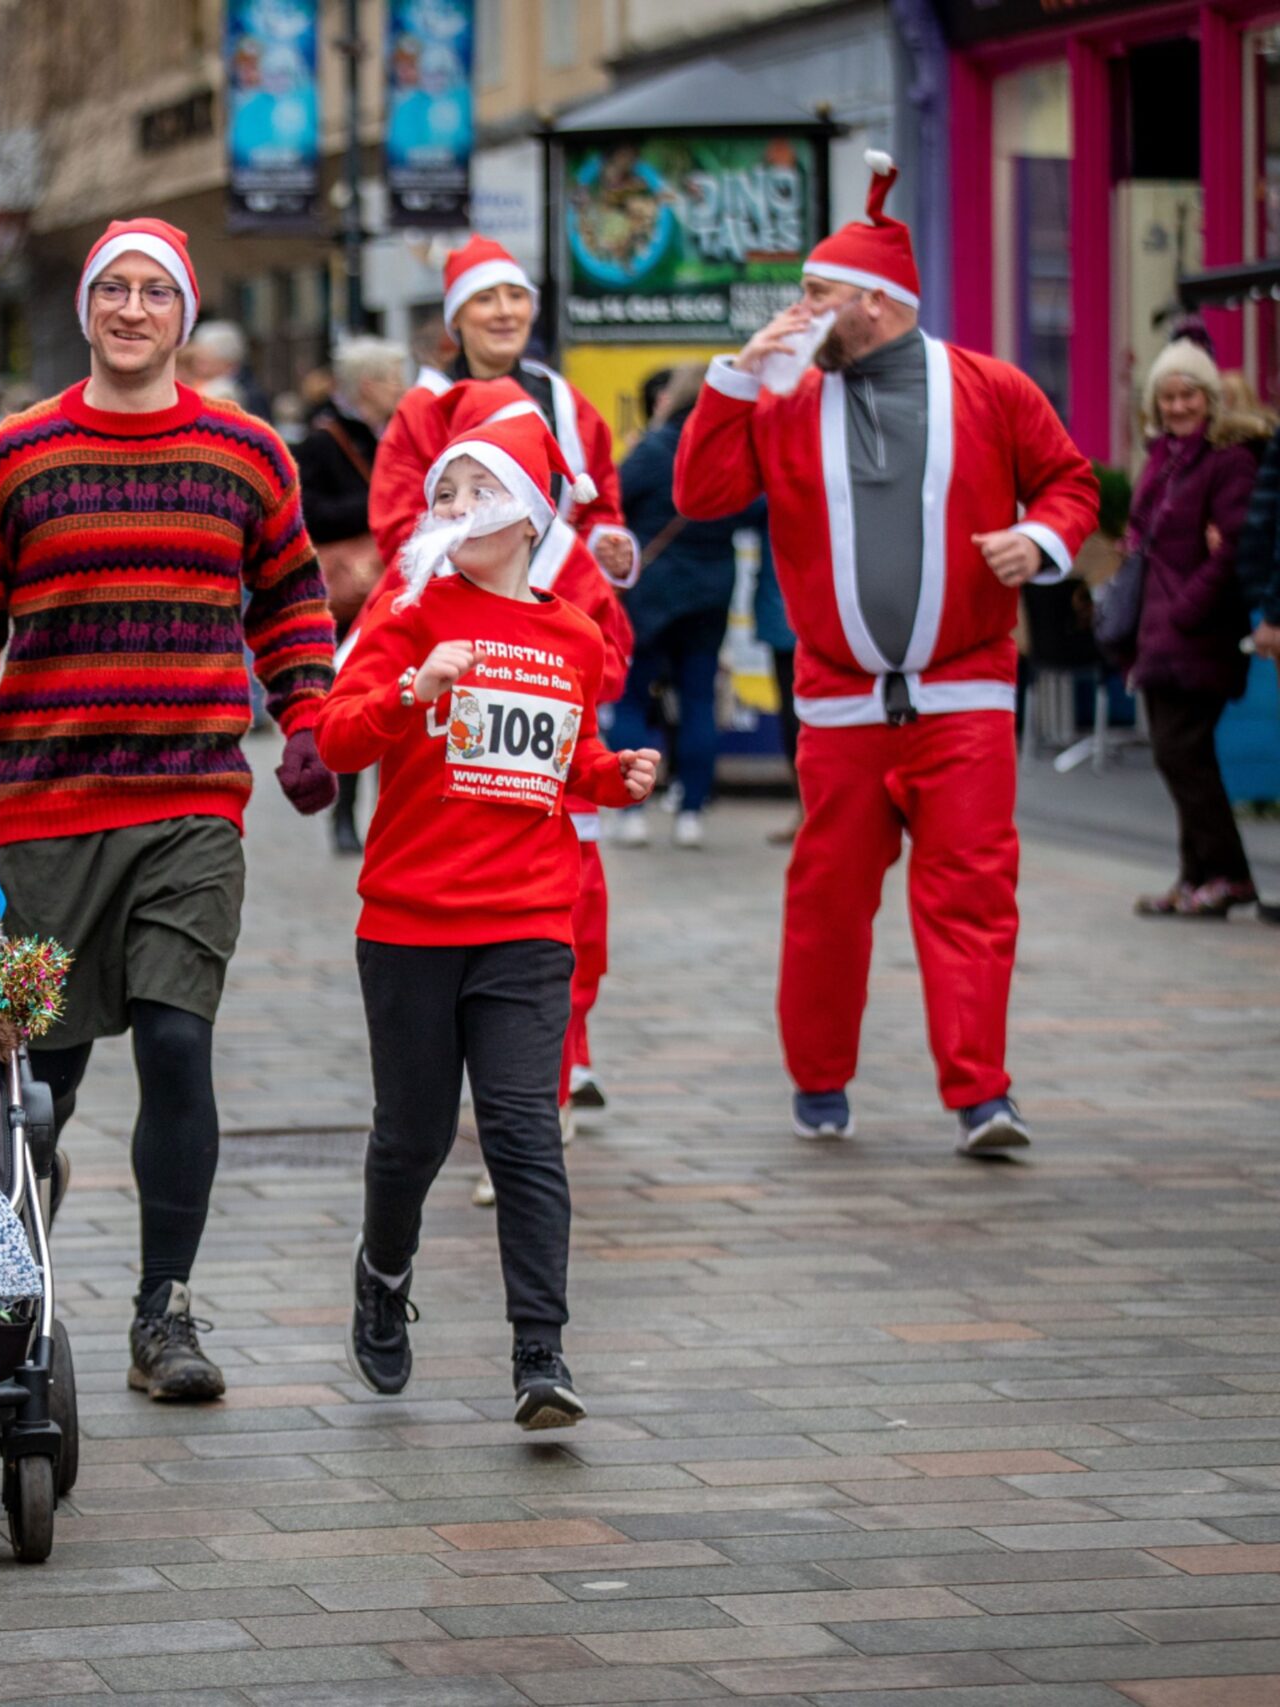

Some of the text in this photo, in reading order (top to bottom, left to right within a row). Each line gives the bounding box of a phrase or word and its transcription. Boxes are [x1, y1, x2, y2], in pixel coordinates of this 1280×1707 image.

[476, 664, 572, 692] Perth Santa Run
[487, 703, 554, 760] 108
